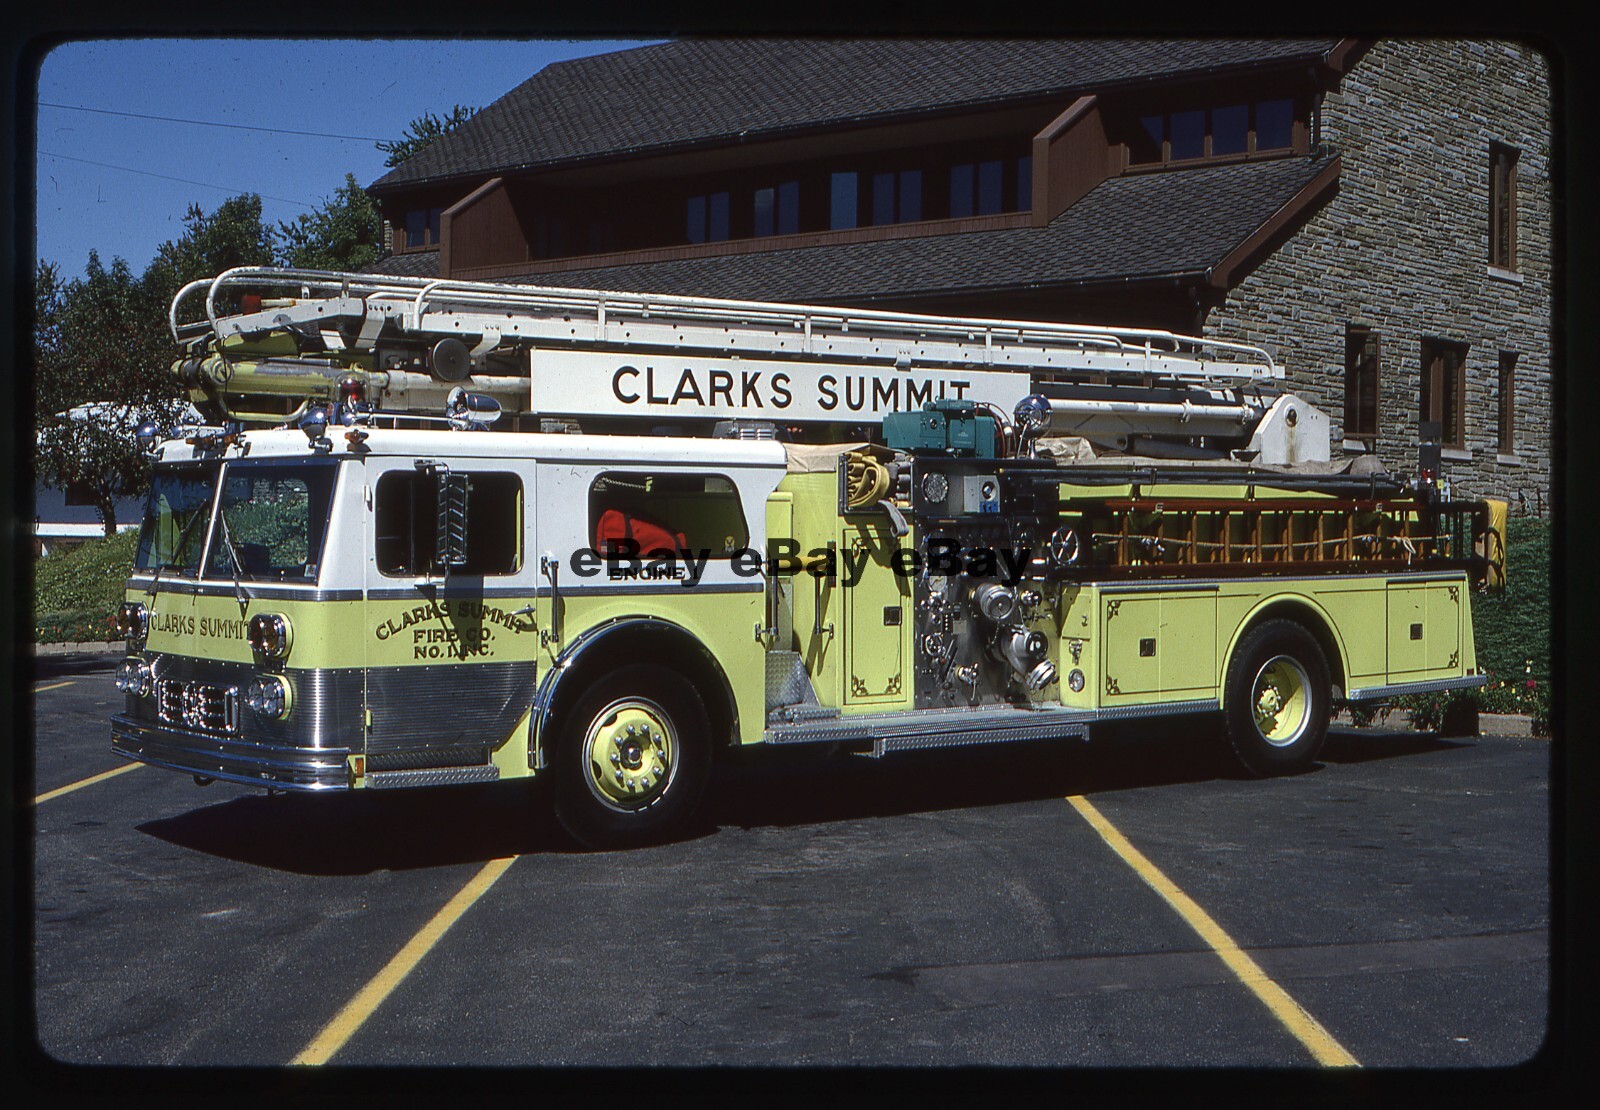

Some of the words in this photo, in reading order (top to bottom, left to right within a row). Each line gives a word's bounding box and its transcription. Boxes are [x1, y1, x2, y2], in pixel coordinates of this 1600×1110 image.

[612, 365, 793, 409] CLARKS
[817, 375, 971, 412] SUMMIT
[609, 567, 686, 581] ENGINE
[150, 613, 195, 636] CLARKS
[375, 601, 451, 641] CLARKS
[457, 600, 524, 635] SUMMIT
[413, 629, 459, 644] FIRE
[465, 627, 496, 642] CO.
